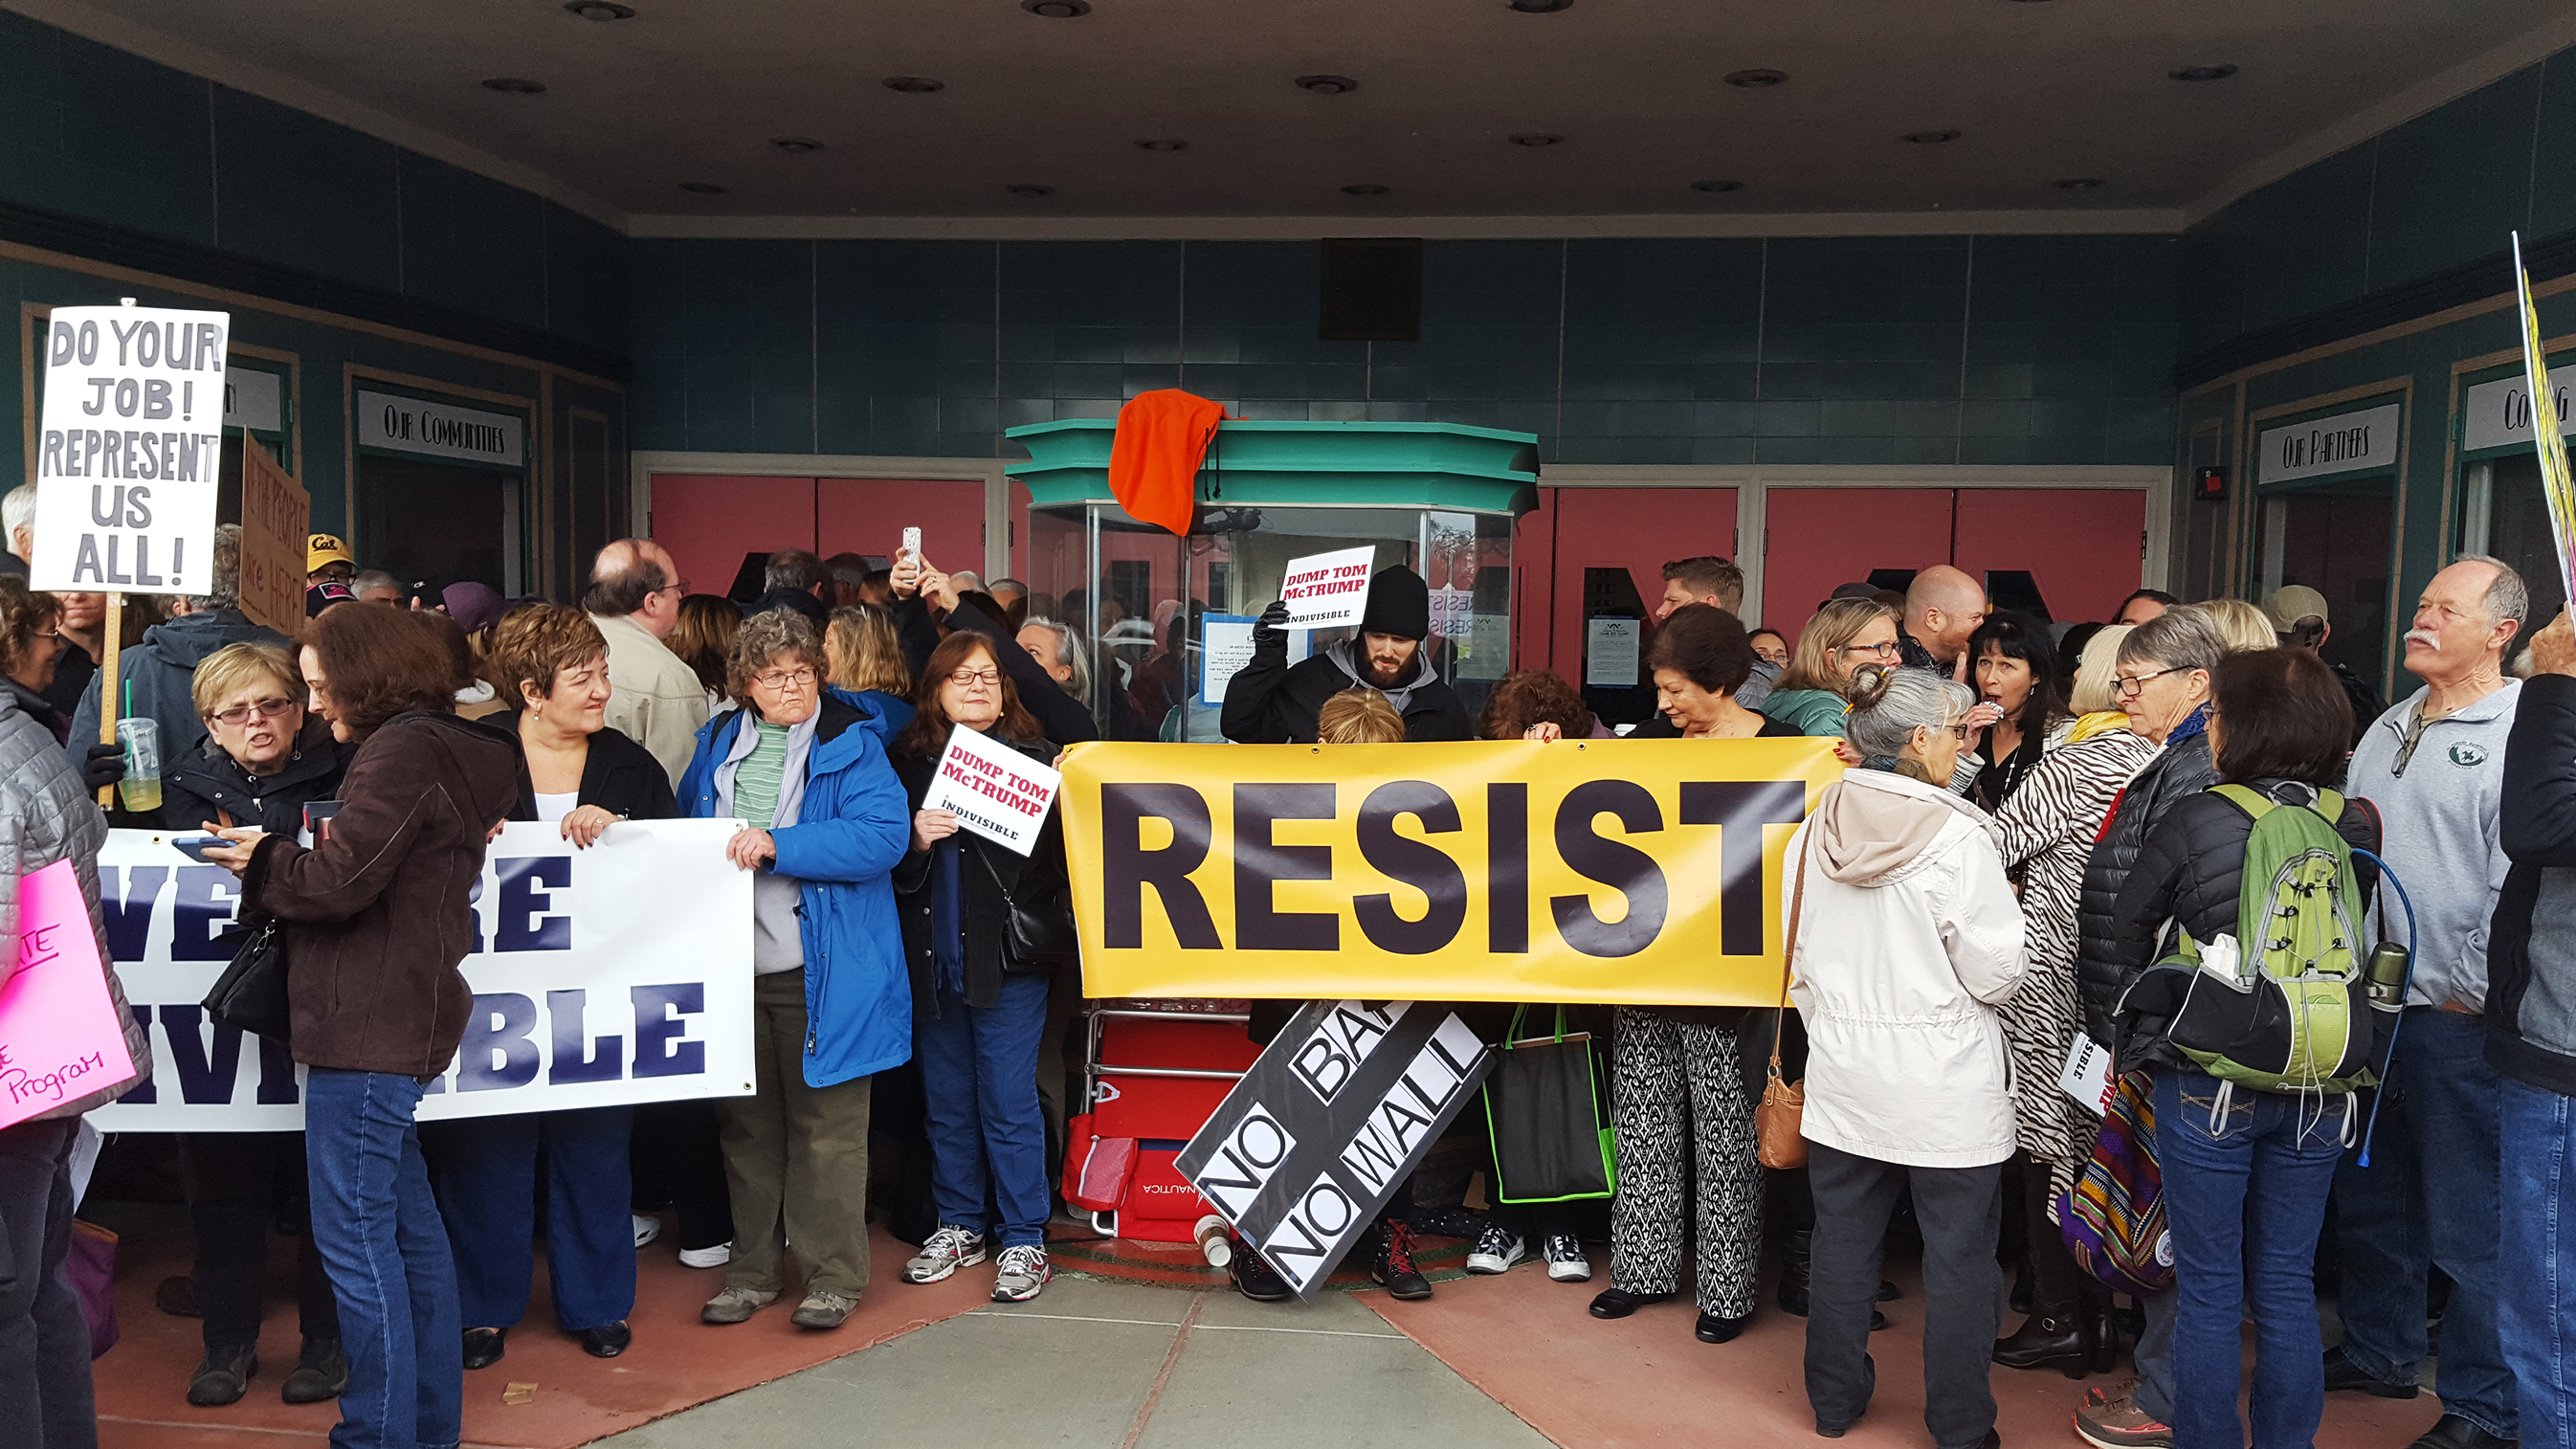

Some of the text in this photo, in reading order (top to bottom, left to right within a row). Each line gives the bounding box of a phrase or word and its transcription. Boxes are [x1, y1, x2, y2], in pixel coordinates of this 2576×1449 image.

[52, 320, 223, 371] DO YOUR
[43, 429, 218, 482] REPRESENT
[91, 484, 152, 529] US
[312, 536, 338, 552] Cal
[1283, 579, 1365, 601] McTRUMP
[1286, 564, 1367, 587] DUMP TOM
[1286, 610, 1350, 623] INDIVISIBLE
[943, 762, 1042, 817] McTRUMP
[949, 746, 1050, 802] DUMP TOM
[942, 798, 1019, 840] INDIVISIBLE
[1100, 780, 1806, 957] RESIST
[1197, 1001, 1393, 1220] NO BA
[1263, 1037, 1484, 1288] NO WALL
[1143, 1185, 1195, 1193] NAUTICA
